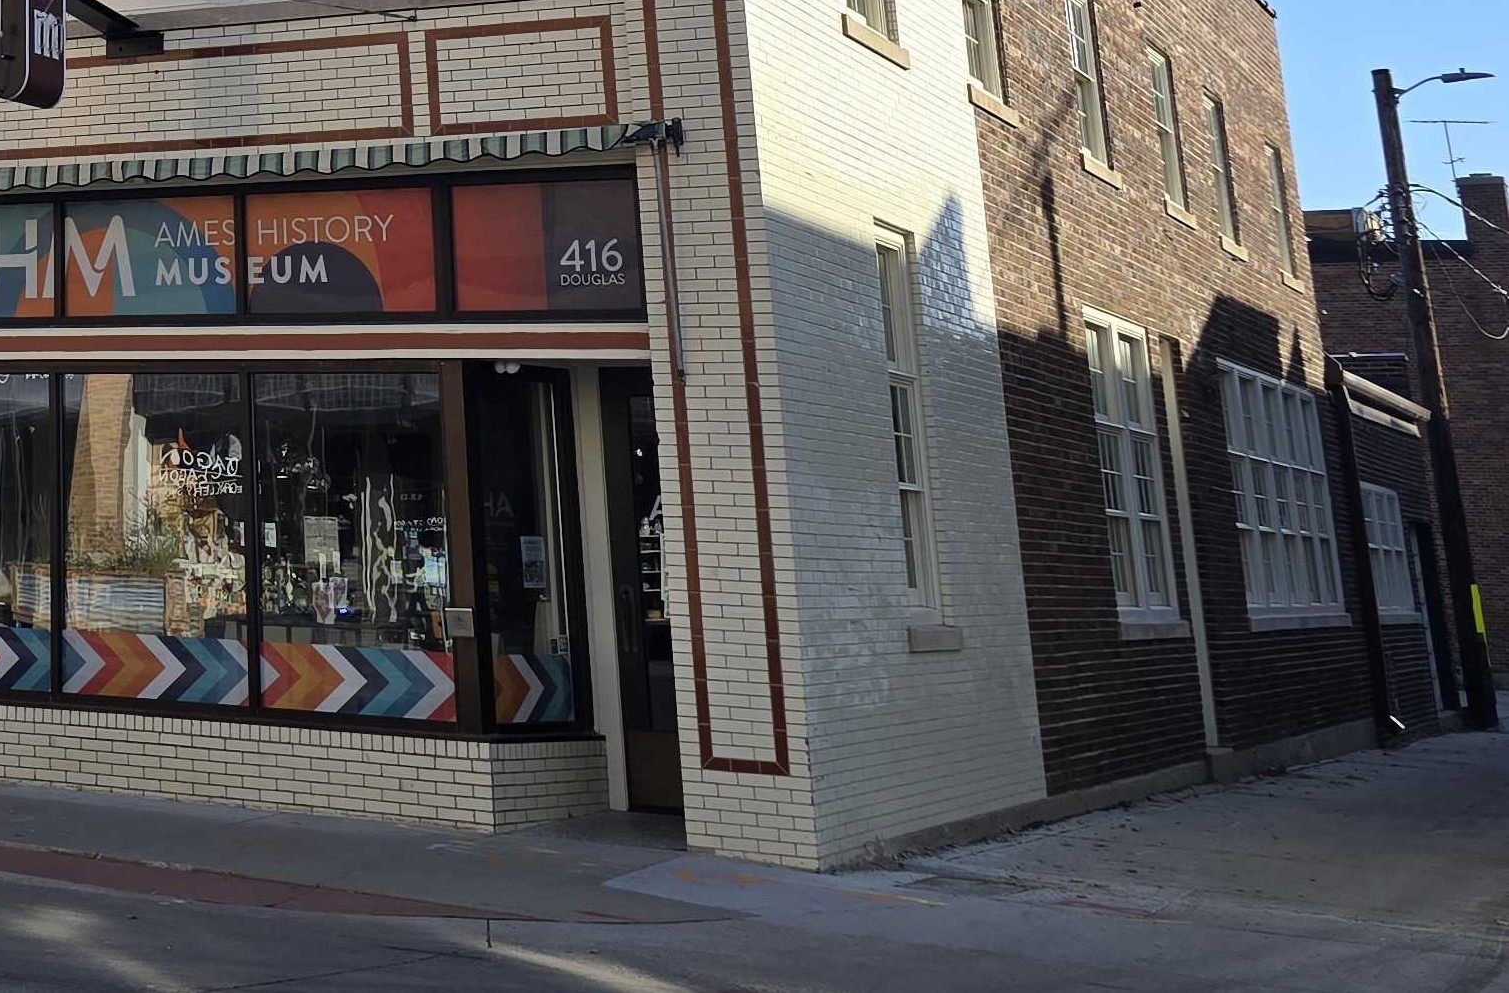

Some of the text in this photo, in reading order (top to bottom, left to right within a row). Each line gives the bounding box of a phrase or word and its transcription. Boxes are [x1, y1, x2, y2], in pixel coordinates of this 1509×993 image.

[154, 213, 394, 248] AMES HISTORY
[155, 254, 329, 286] MUSEUM
[559, 238, 623, 272] 416
[559, 273, 626, 286] DOUGLAS
